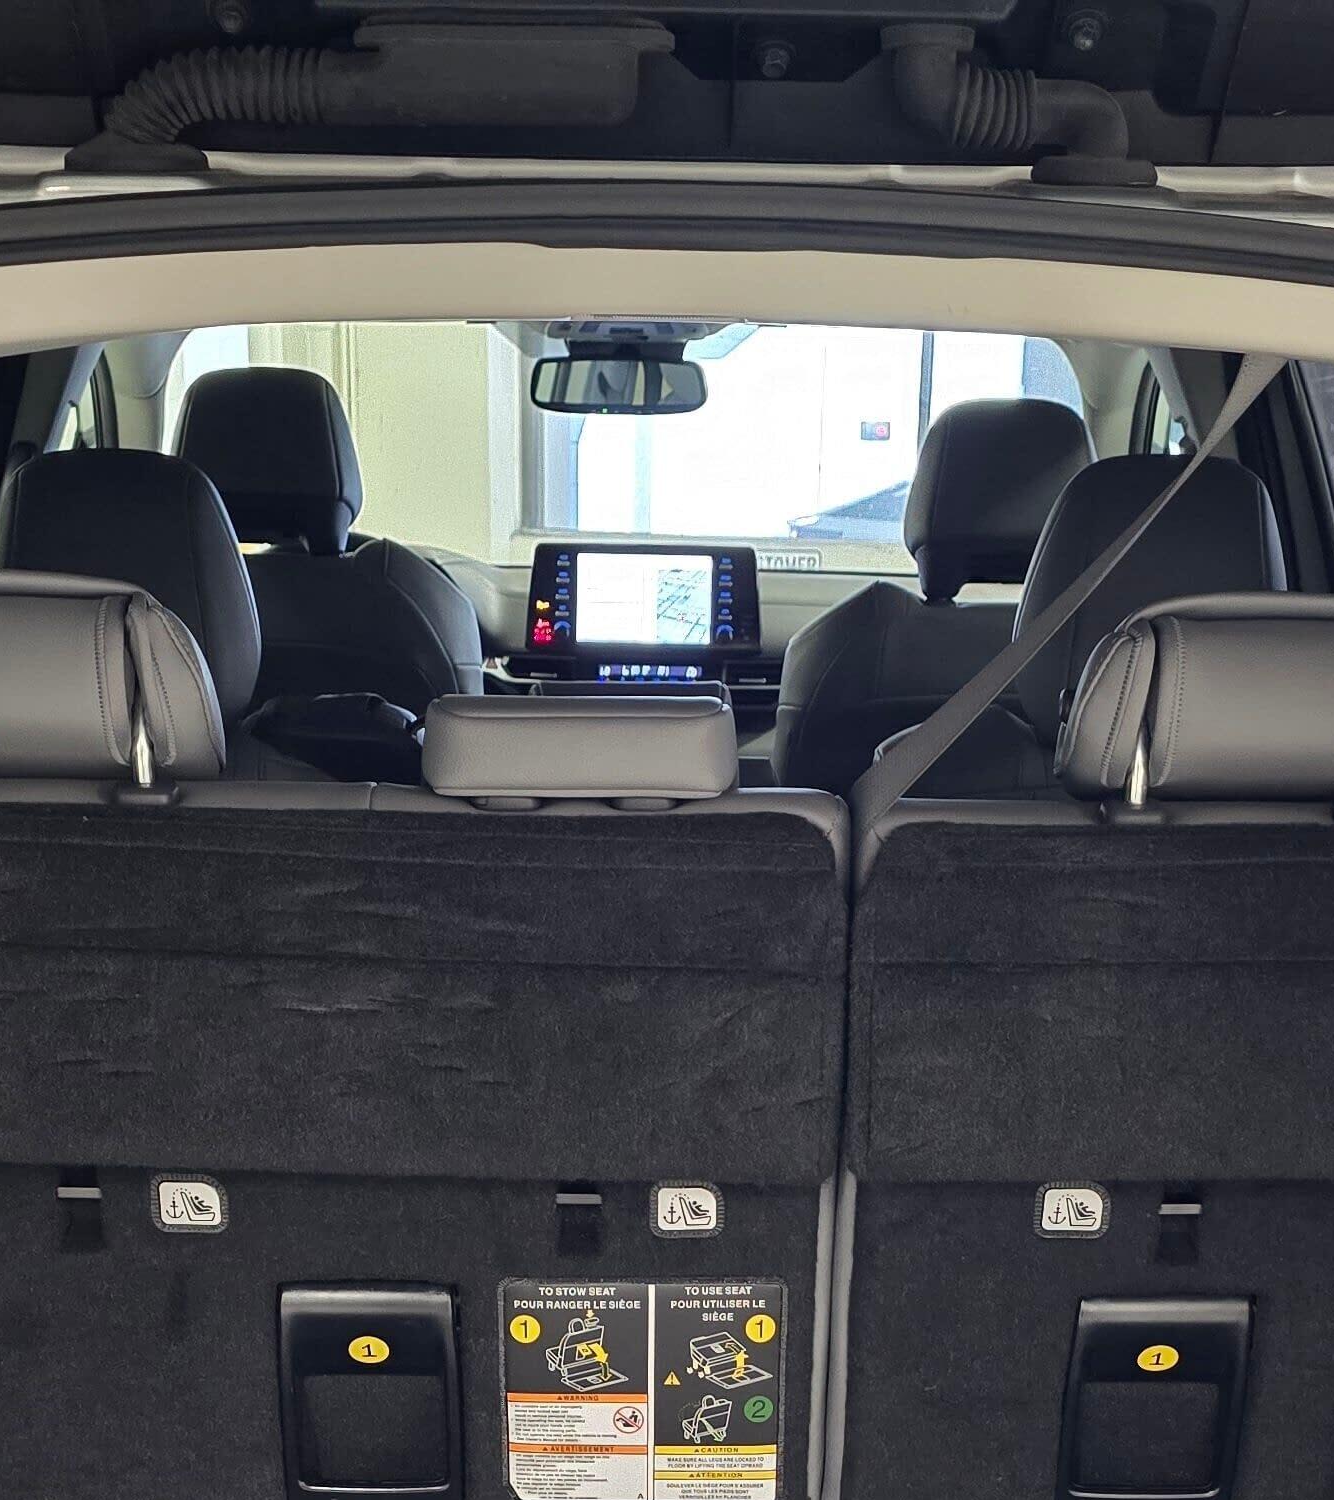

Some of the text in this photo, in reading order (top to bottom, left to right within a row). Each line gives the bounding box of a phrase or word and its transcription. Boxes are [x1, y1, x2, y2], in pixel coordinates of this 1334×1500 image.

[539, 1287, 616, 1296] TO STOW SEAT
[684, 1286, 753, 1295] TO USE SEAT
[514, 1298, 641, 1309] POUR RANGER LE SIÈGE
[670, 1300, 766, 1309] POUR UTILISER LE
[701, 1311, 734, 1321] SIÈGE
[520, 1320, 528, 1338] 1
[755, 1319, 763, 1338] 1
[361, 1344, 377, 1357] 1
[1149, 1352, 1164, 1365] 1
[751, 1399, 766, 1419] 2
